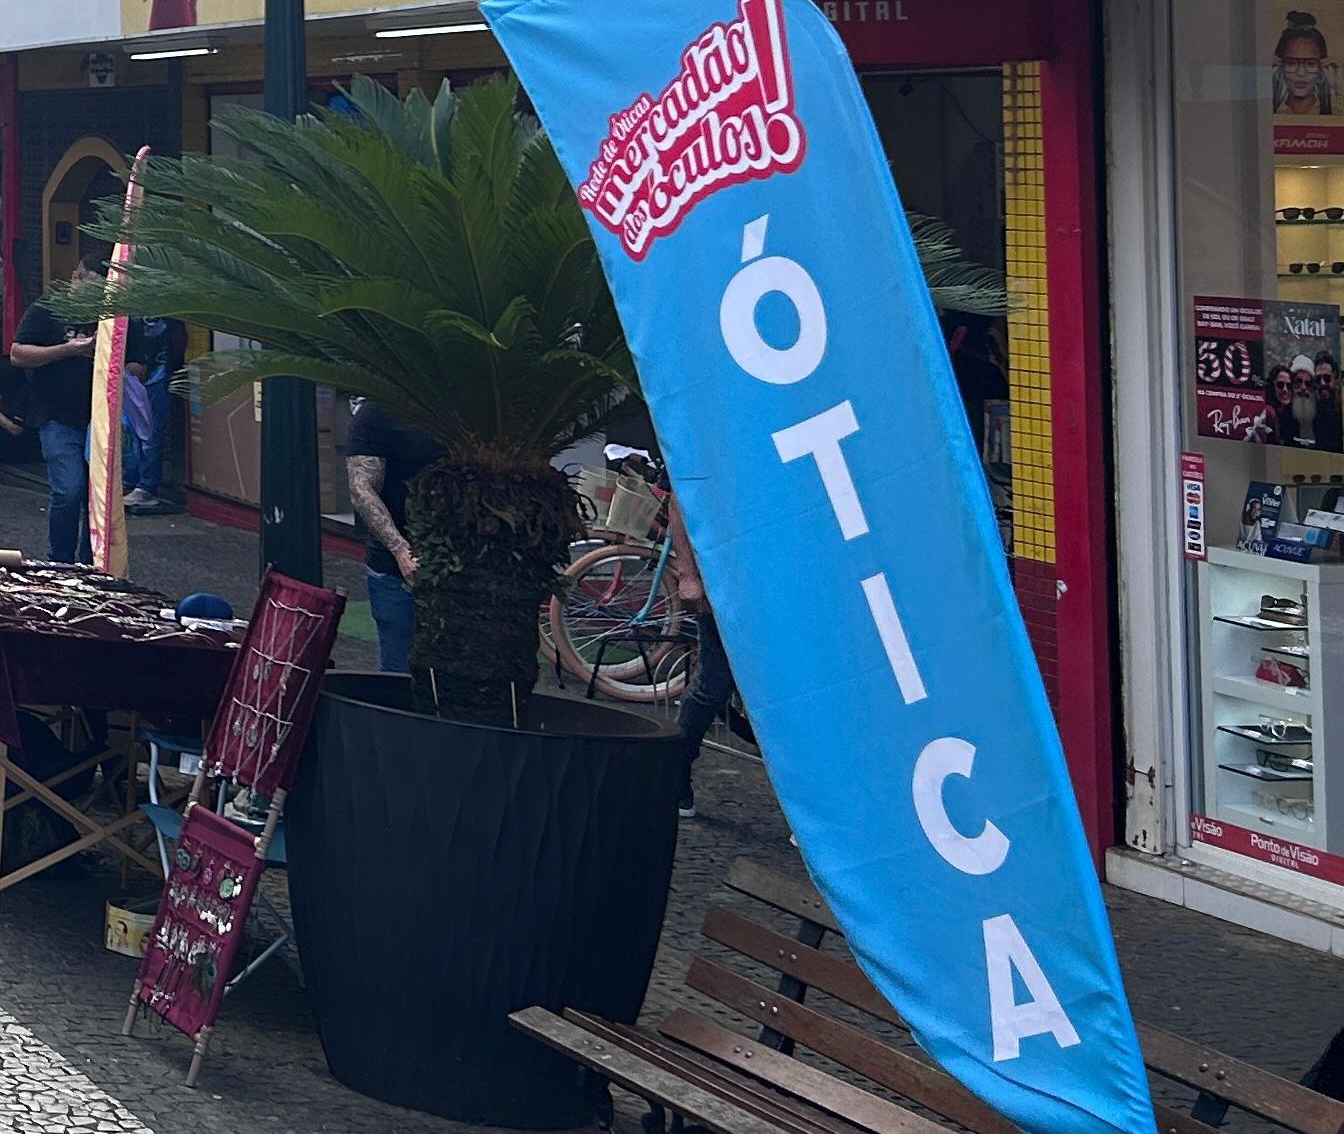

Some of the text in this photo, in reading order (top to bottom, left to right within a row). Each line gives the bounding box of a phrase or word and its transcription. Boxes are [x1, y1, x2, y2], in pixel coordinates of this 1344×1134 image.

[823, 0, 909, 22] GITAL
[1250, 833, 1281, 855] Ponto
[1289, 844, 1319, 866] Visão
